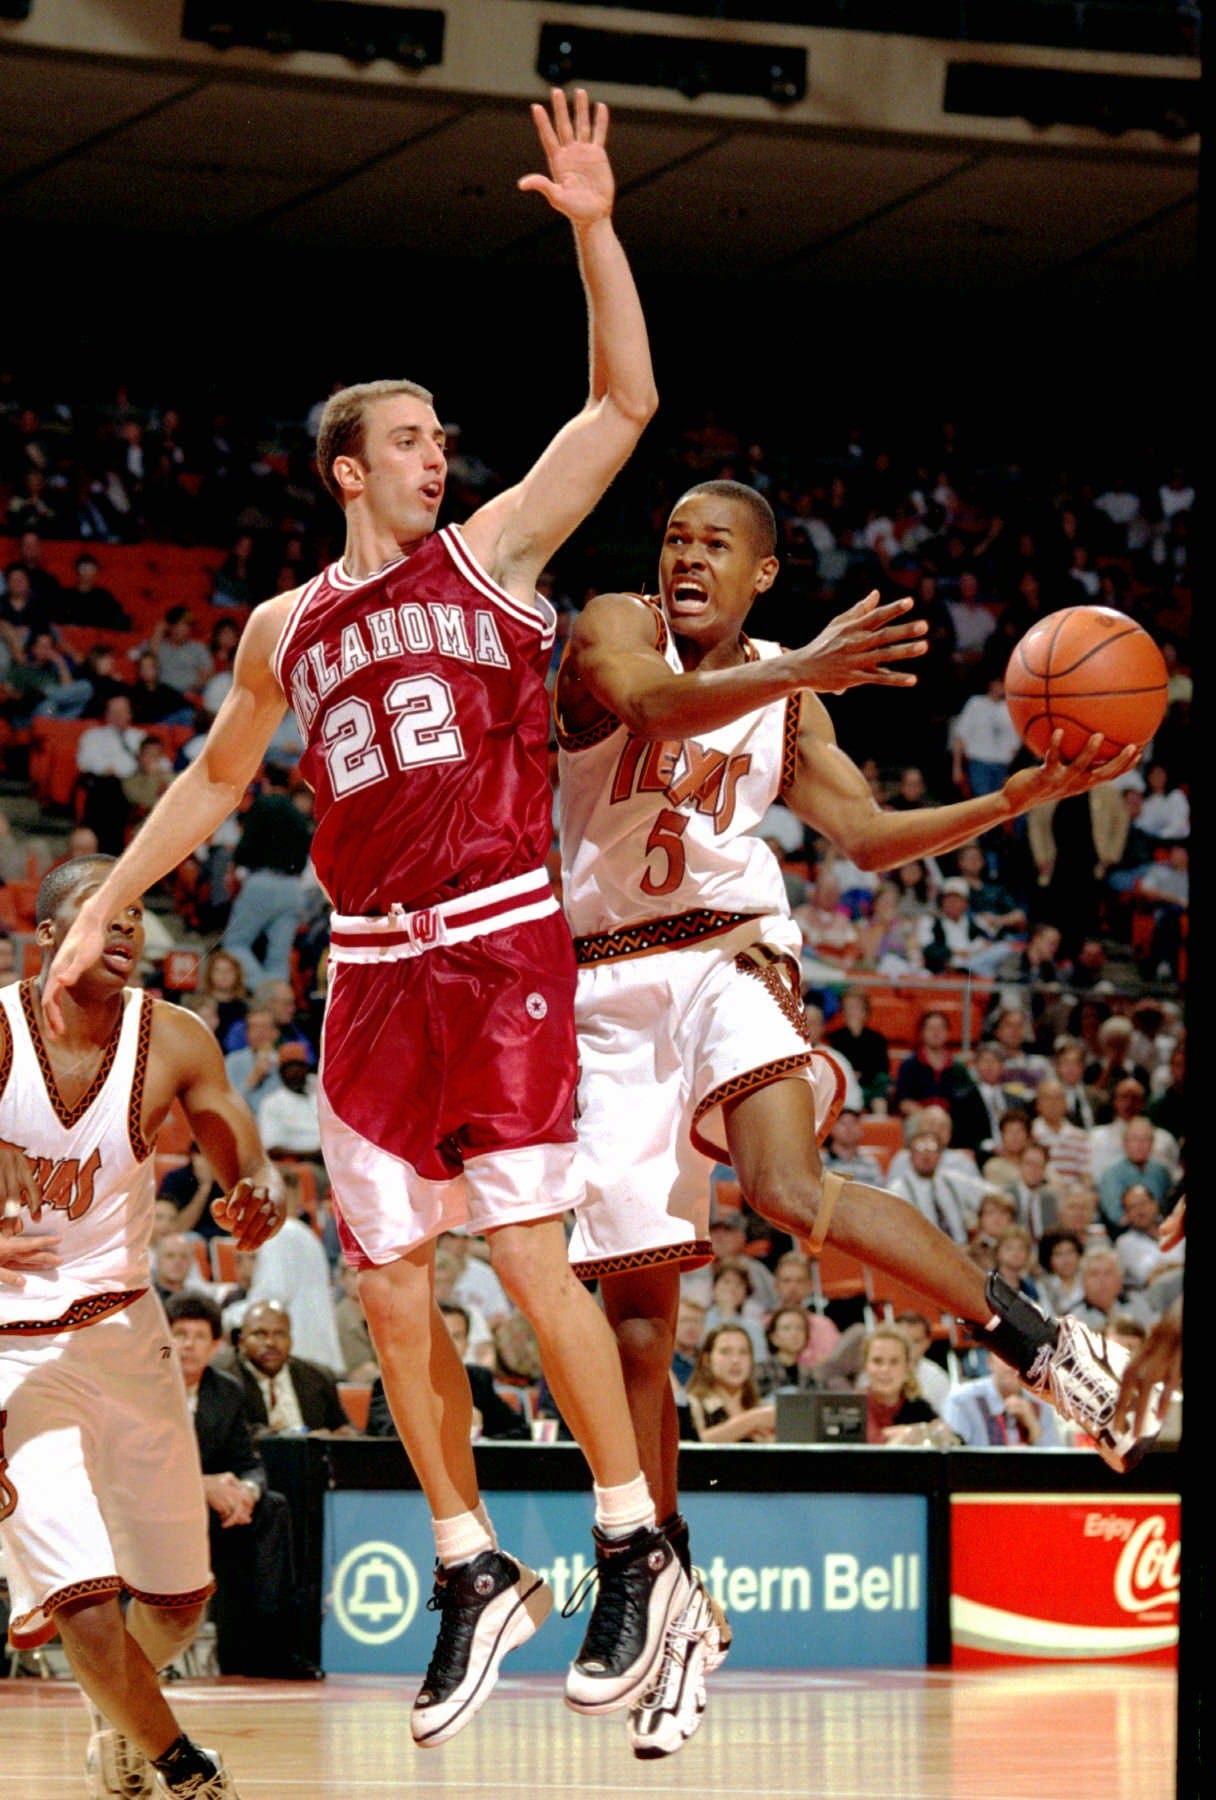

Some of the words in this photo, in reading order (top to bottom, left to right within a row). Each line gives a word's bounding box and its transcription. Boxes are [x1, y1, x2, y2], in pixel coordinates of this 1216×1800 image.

[321, 672, 466, 802] 22
[640, 808, 690, 896] 5
[1084, 1512, 1136, 1542] Enjoy
[824, 1553, 920, 1612] Bell
